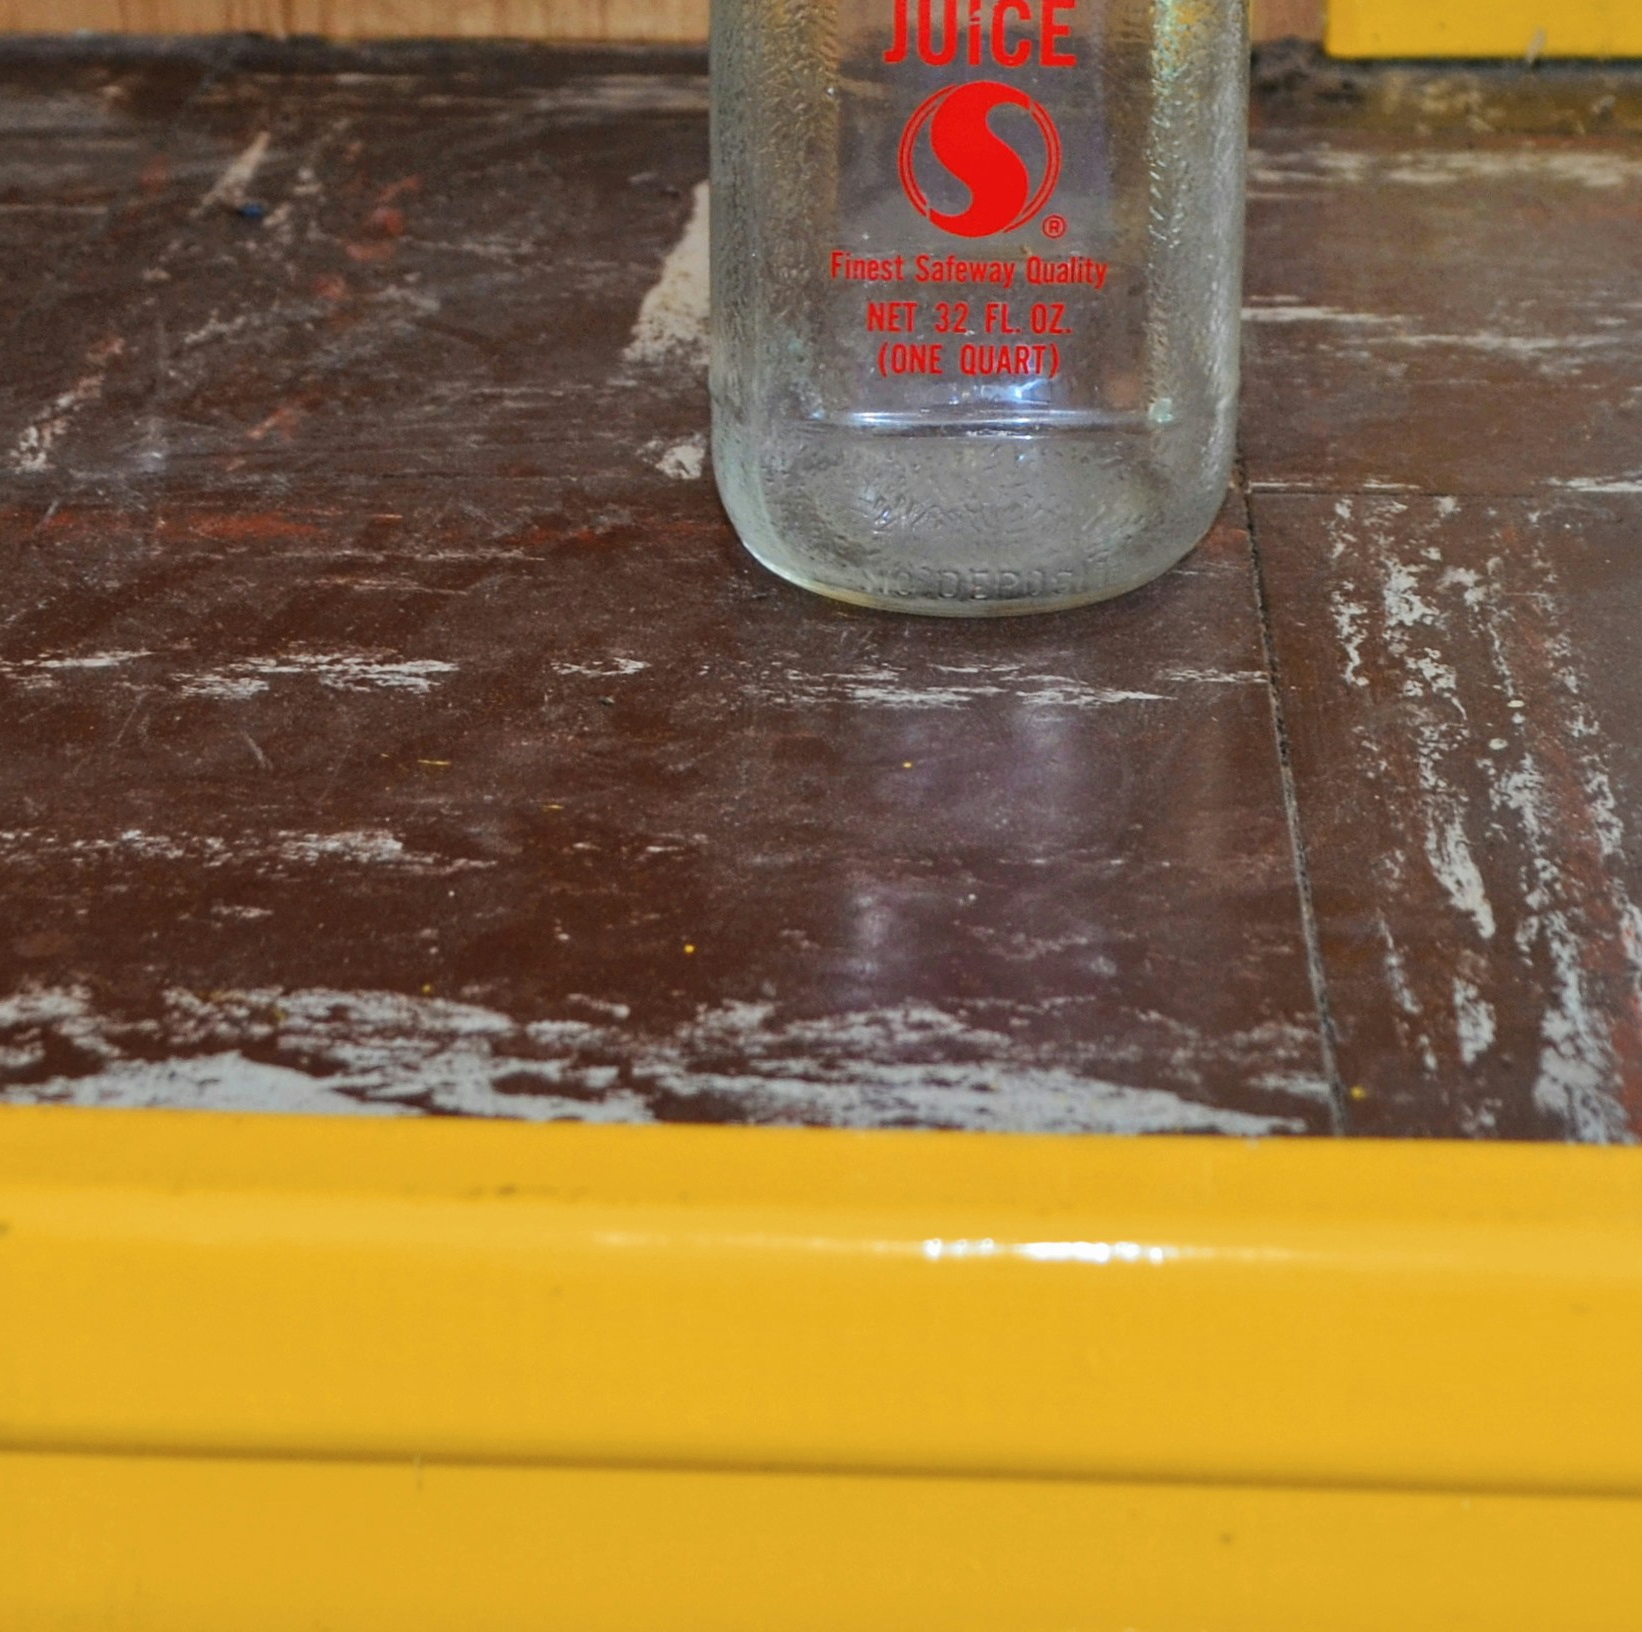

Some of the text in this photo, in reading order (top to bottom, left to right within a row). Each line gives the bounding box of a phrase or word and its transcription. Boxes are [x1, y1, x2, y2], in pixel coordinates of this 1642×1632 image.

[830, 250, 1108, 290] Finest Safeway Quality
[866, 301, 1073, 335] NET 32 FL. OZ.
[877, 342, 1062, 378] (ONE QUART)
